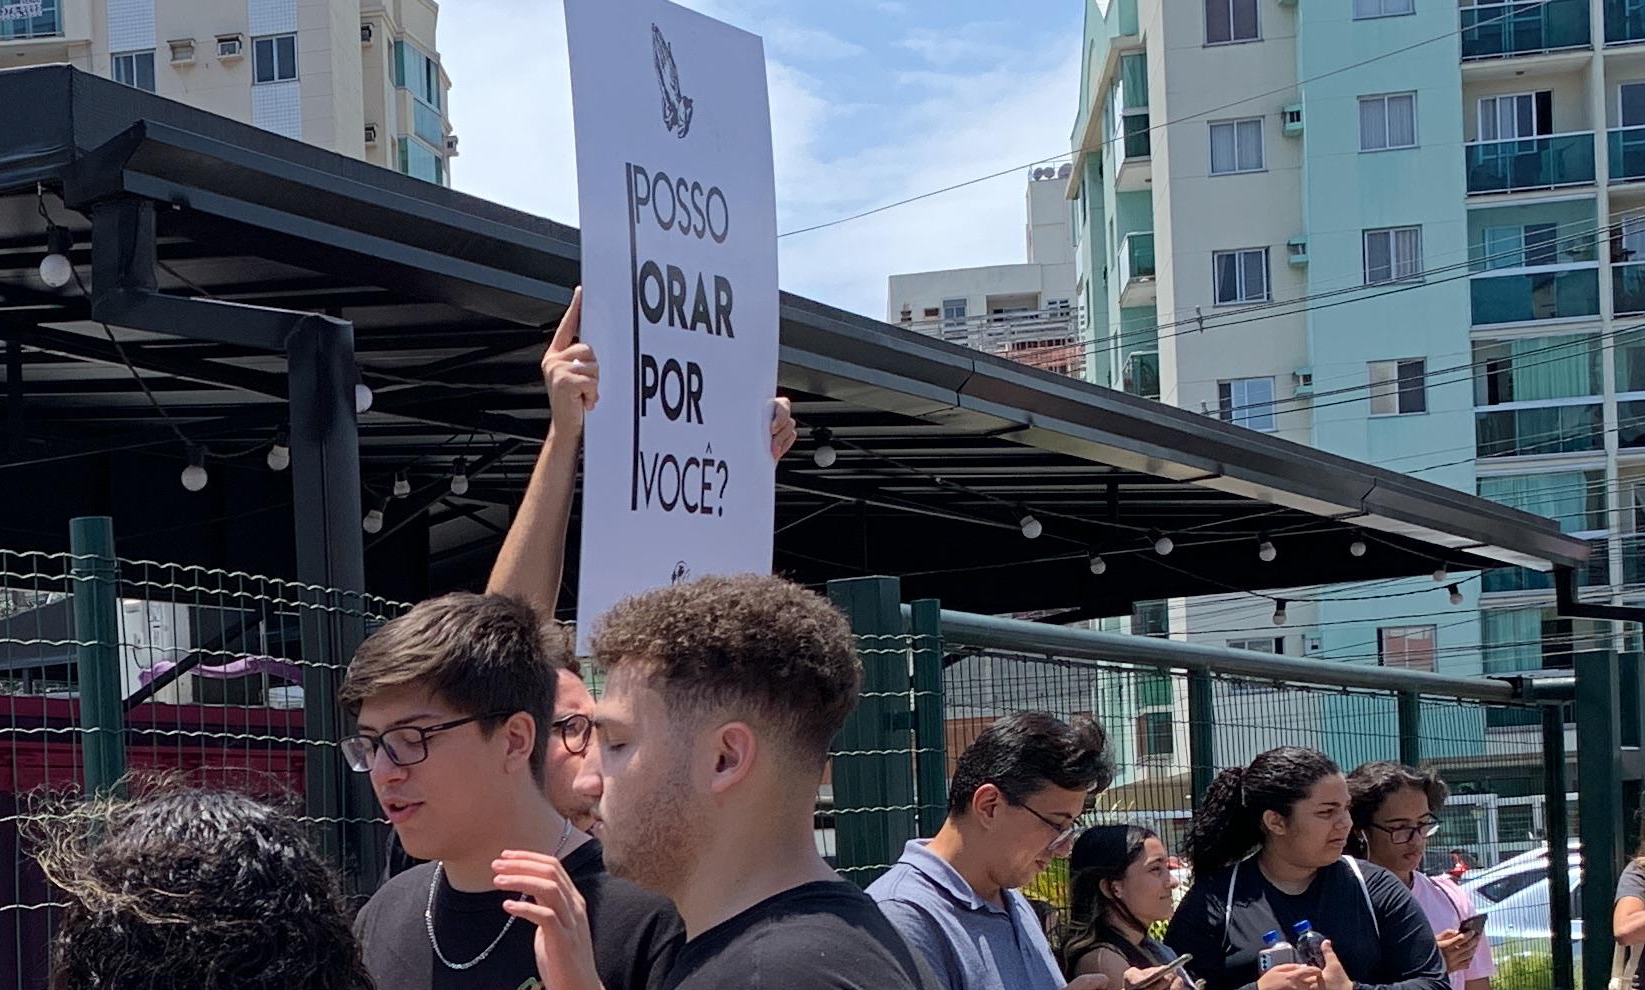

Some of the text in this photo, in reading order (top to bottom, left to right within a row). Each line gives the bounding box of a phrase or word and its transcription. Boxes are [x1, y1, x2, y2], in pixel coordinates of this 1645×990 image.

[632, 164, 730, 244] POSSO
[638, 259, 735, 339] ORAR
[640, 354, 705, 425] POR
[639, 442, 729, 518] VOCÊ?
